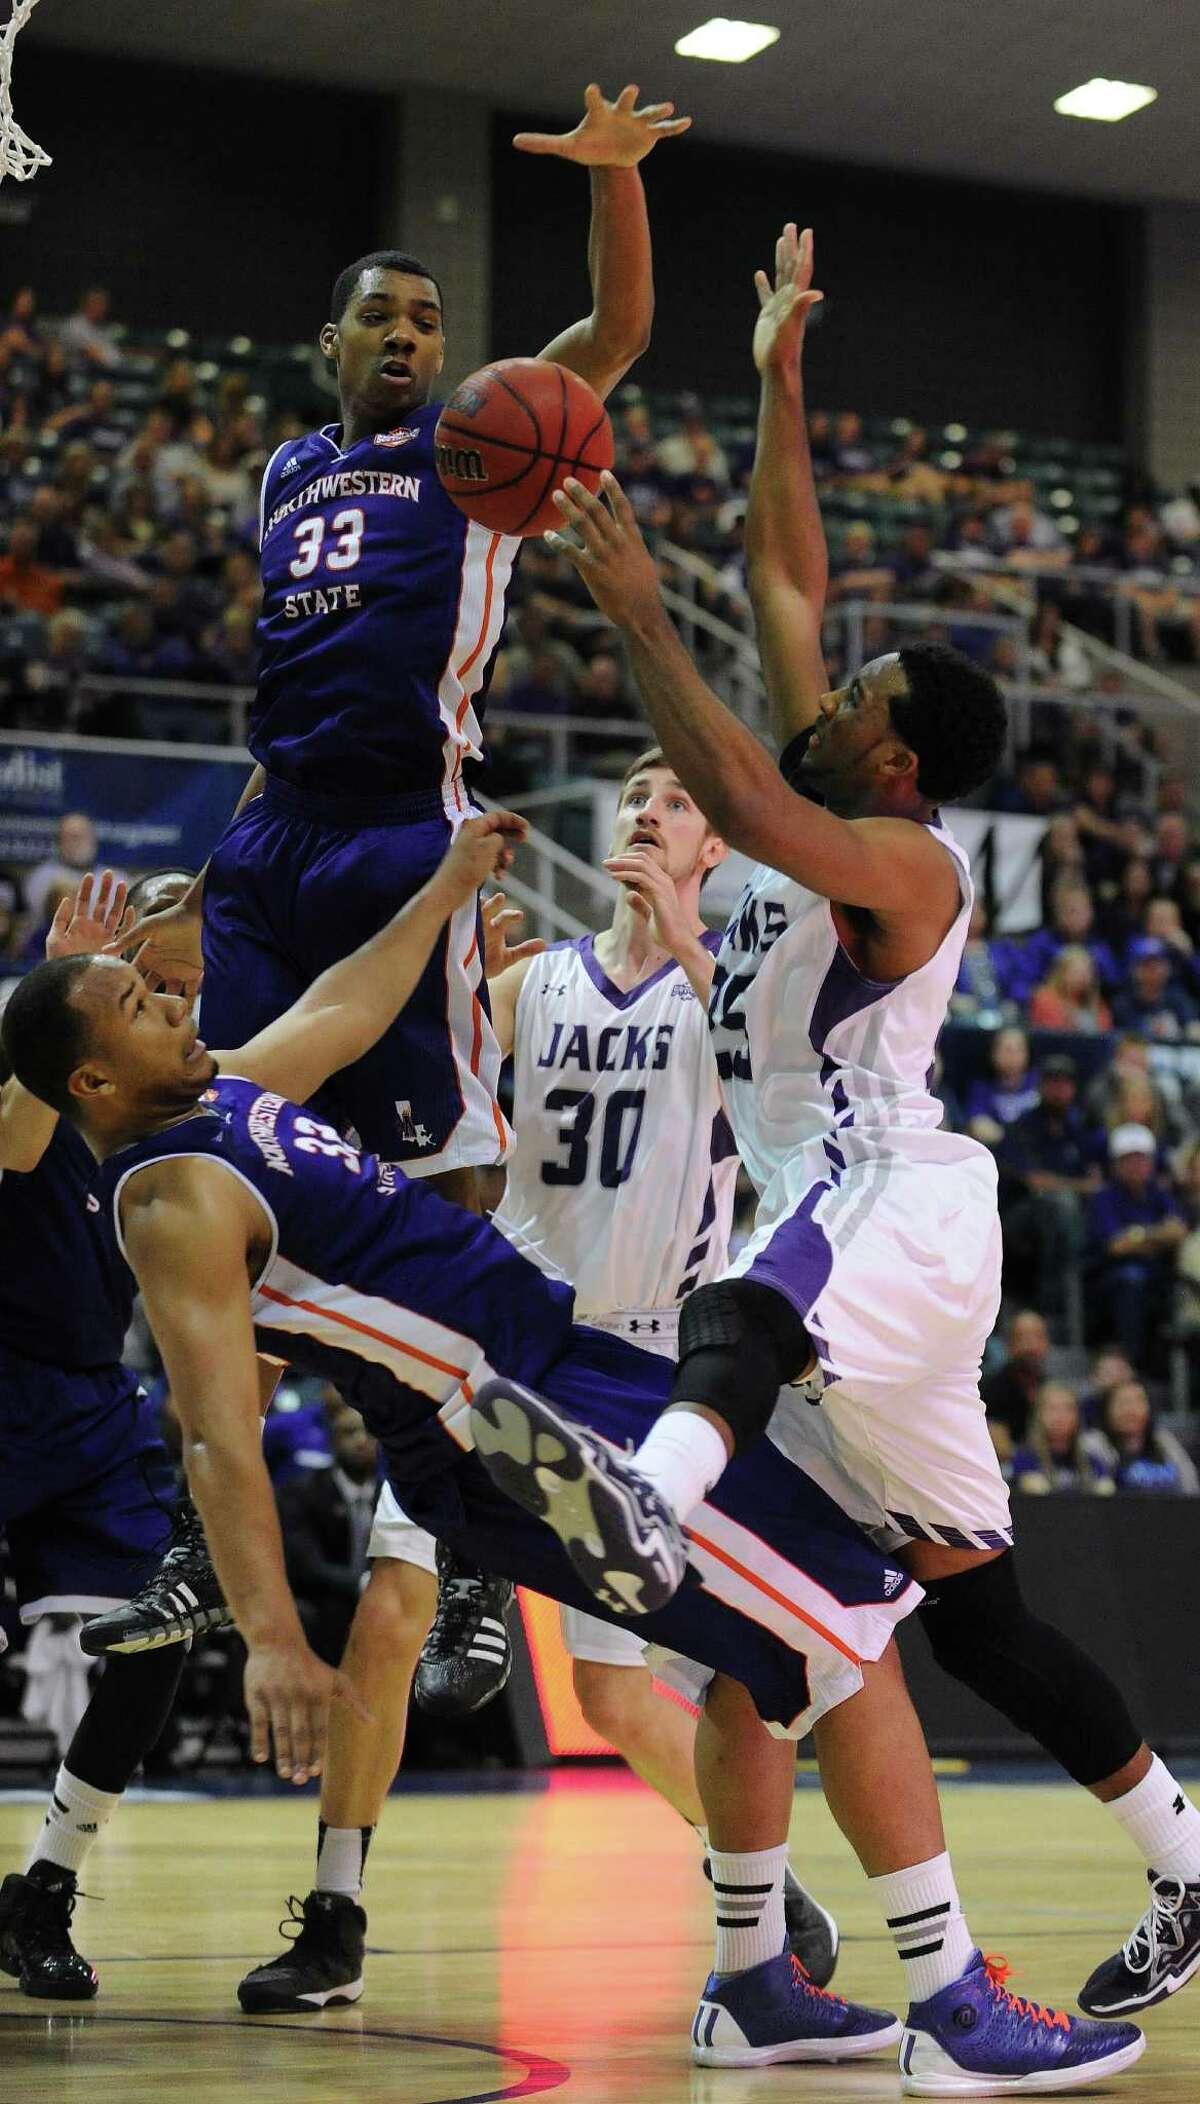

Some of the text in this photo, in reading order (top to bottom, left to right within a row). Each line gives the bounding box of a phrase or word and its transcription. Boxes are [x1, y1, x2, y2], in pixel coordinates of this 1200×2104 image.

[289, 508, 365, 579] 33
[285, 584, 361, 619] STATE
[537, 1023, 675, 1071] JACKS
[541, 1088, 647, 1188] 30
